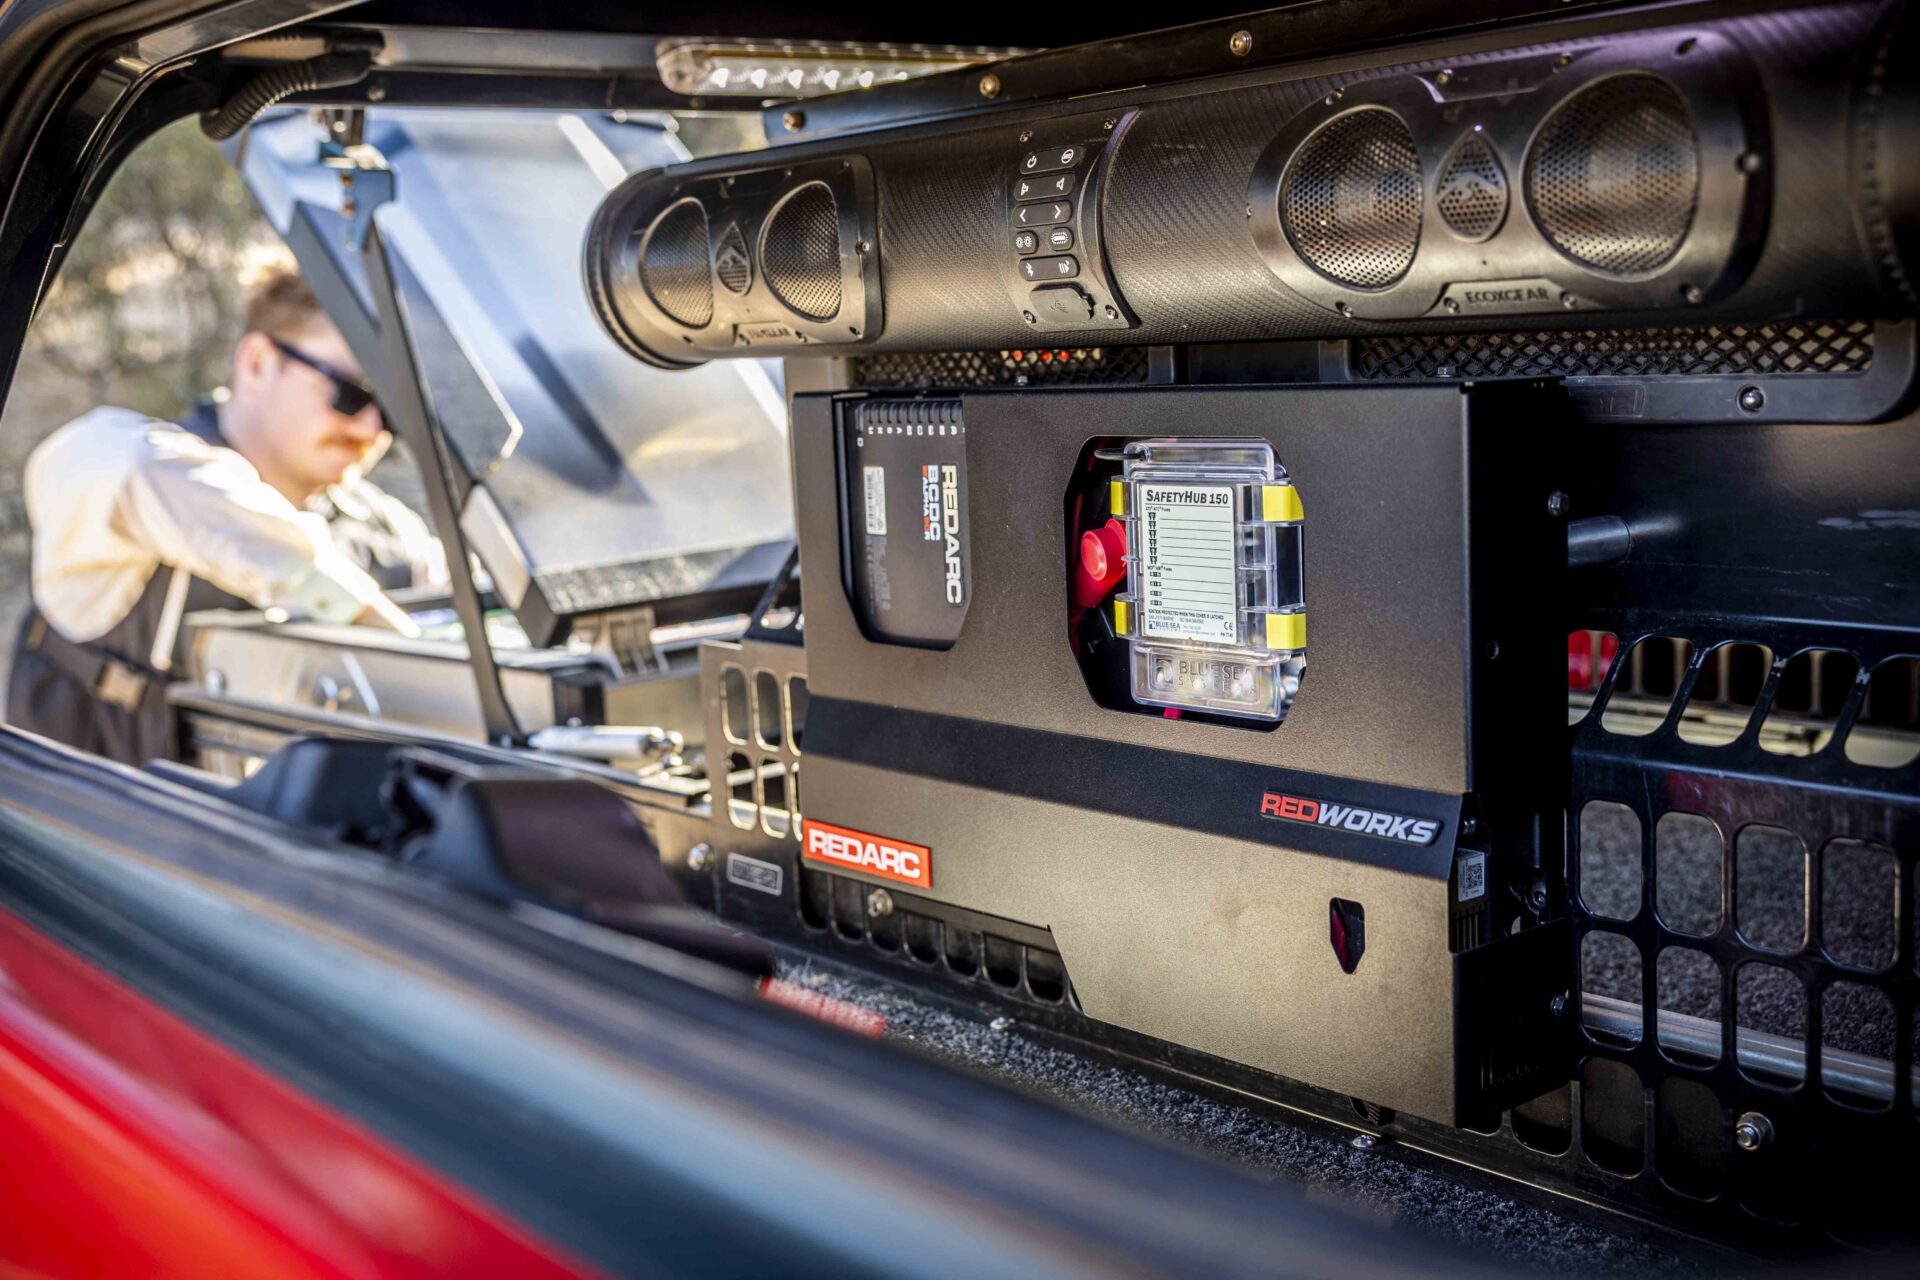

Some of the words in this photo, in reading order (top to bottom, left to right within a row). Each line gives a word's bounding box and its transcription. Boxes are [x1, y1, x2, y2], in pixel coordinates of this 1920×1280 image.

[1464, 288, 1550, 303] ECOXGEAR
[928, 464, 941, 541] BCDC
[1209, 493, 1229, 504] 150
[941, 464, 962, 604] REDARC
[1260, 792, 1437, 843] REDWORKS
[808, 828, 921, 879] REDARC
